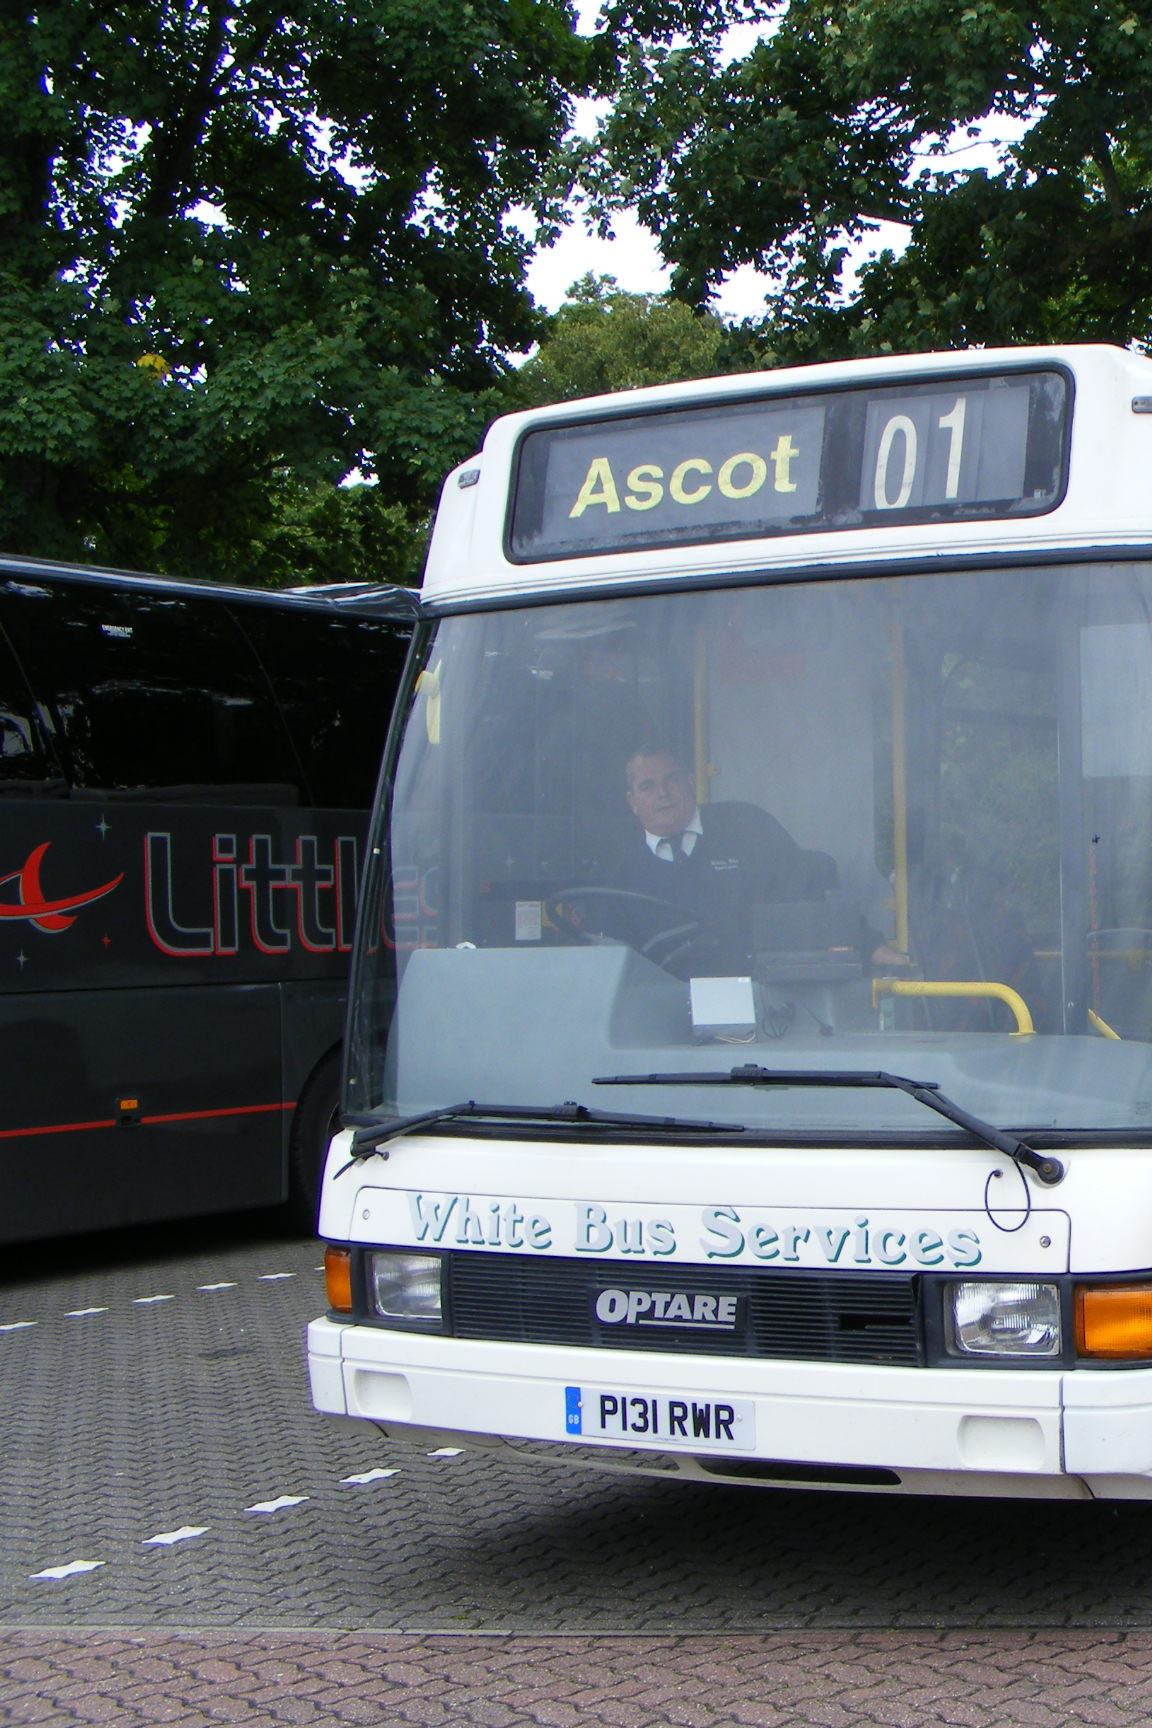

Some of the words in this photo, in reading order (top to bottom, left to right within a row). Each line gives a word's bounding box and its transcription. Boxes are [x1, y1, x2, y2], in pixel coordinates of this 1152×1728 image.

[568, 434, 799, 519] Ascot
[873, 397, 966, 510] 01
[407, 1193, 552, 1250] White
[574, 1203, 677, 1256] Bus
[699, 1205, 983, 1268] Services
[596, 1289, 738, 1324] OPTARE
[568, 1413, 580, 1425] GB
[600, 1394, 658, 1434] P131
[668, 1401, 734, 1441] RWR
